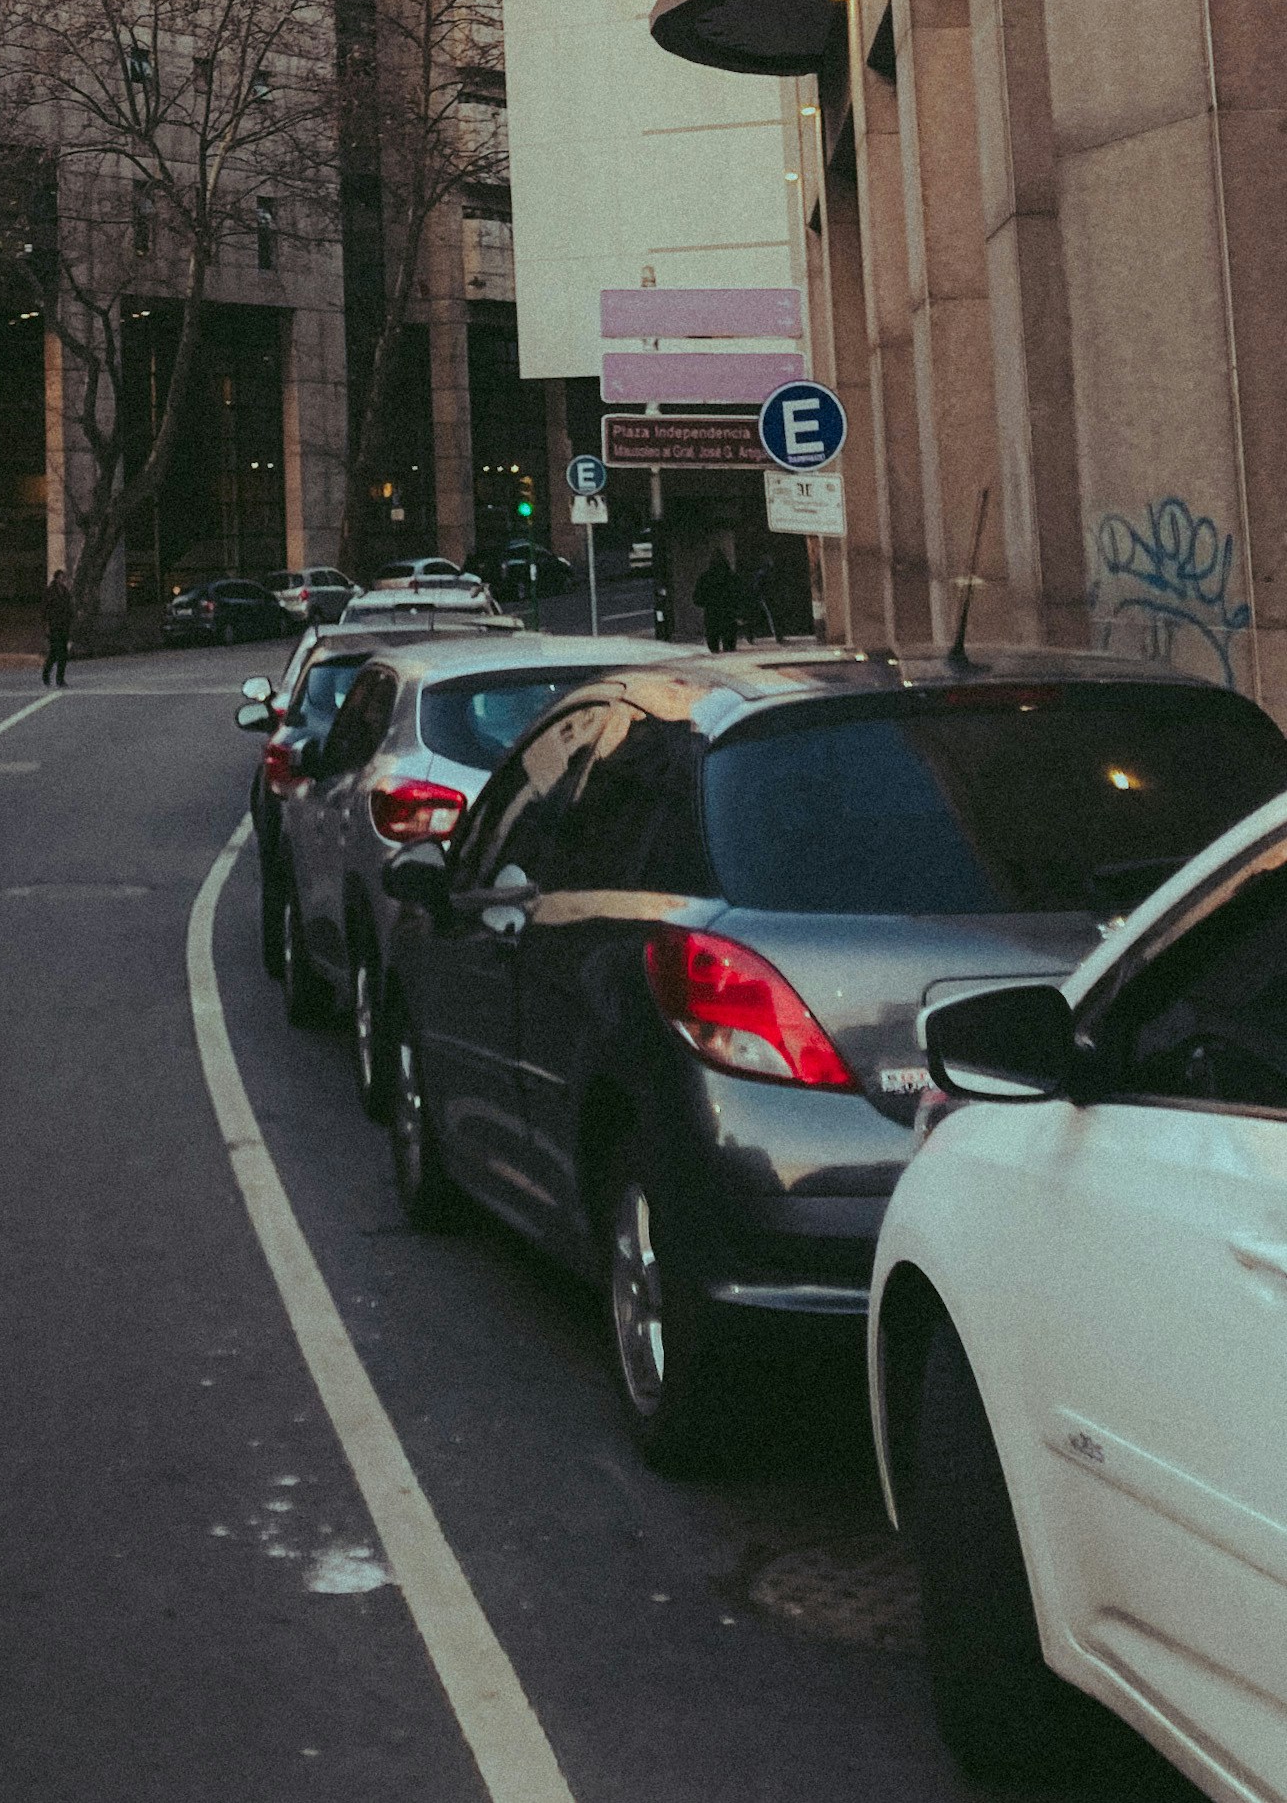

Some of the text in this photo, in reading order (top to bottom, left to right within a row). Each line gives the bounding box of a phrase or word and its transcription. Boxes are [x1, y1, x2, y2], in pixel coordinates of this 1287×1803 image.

[613, 424, 751, 440] Plaza Independencia
[782, 398, 825, 455] E
[577, 462, 597, 488] E
